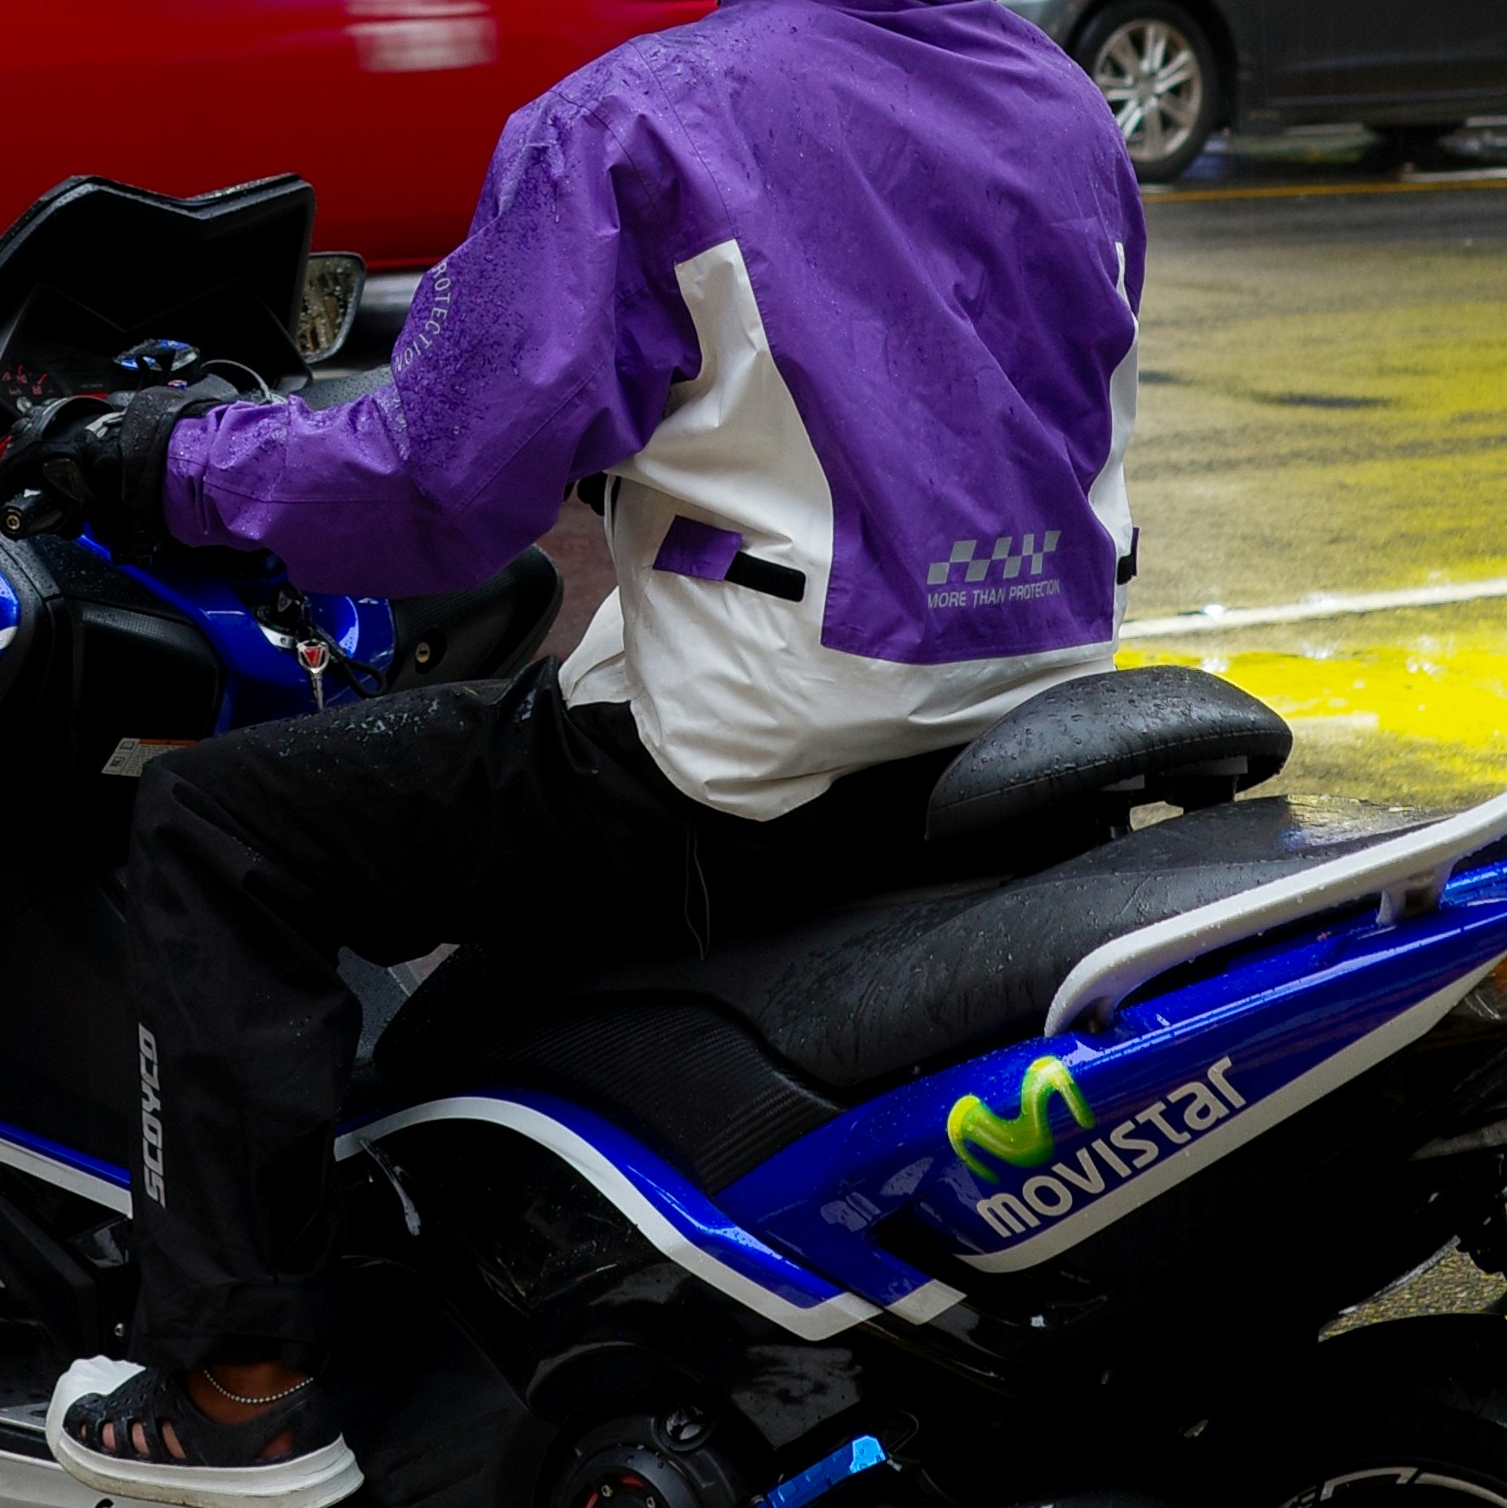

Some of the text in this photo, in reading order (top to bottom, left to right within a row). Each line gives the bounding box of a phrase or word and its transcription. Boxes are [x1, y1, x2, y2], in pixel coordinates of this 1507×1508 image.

[394, 261, 452, 372] ROTECTION
[927, 578, 1061, 610] MORE THAN PROTECTION
[975, 1056, 1248, 1239] movistar
